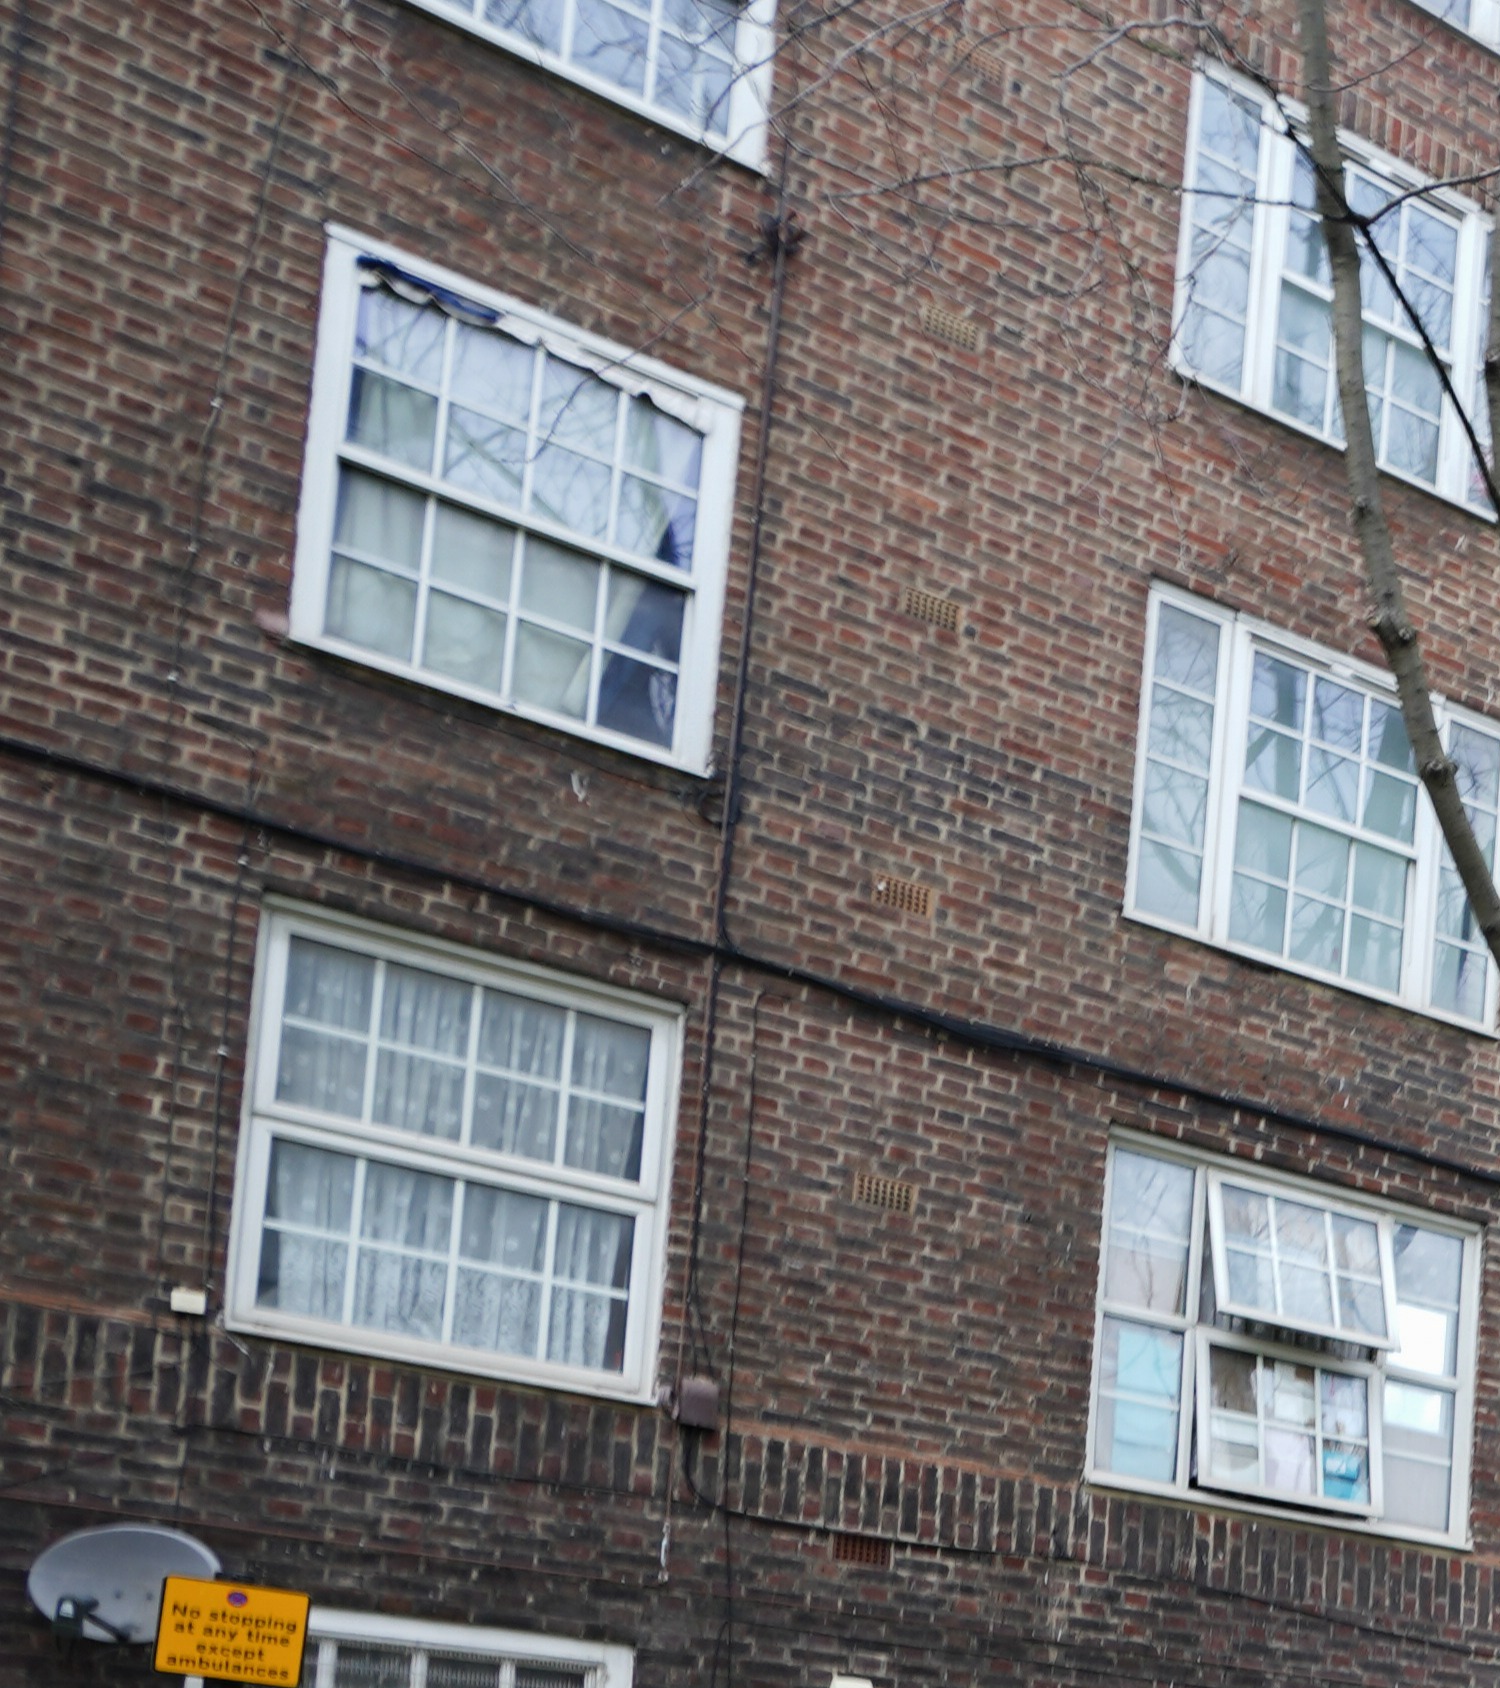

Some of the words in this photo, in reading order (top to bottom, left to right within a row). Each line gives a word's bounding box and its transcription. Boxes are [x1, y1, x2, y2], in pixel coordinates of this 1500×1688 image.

[173, 1603, 200, 1619] No
[209, 1607, 297, 1634] stopping
[174, 1620, 194, 1635] at
[203, 1626, 237, 1642] any
[247, 1630, 290, 1648] time
[196, 1642, 265, 1662] except
[166, 1655, 289, 1680] ambulances
